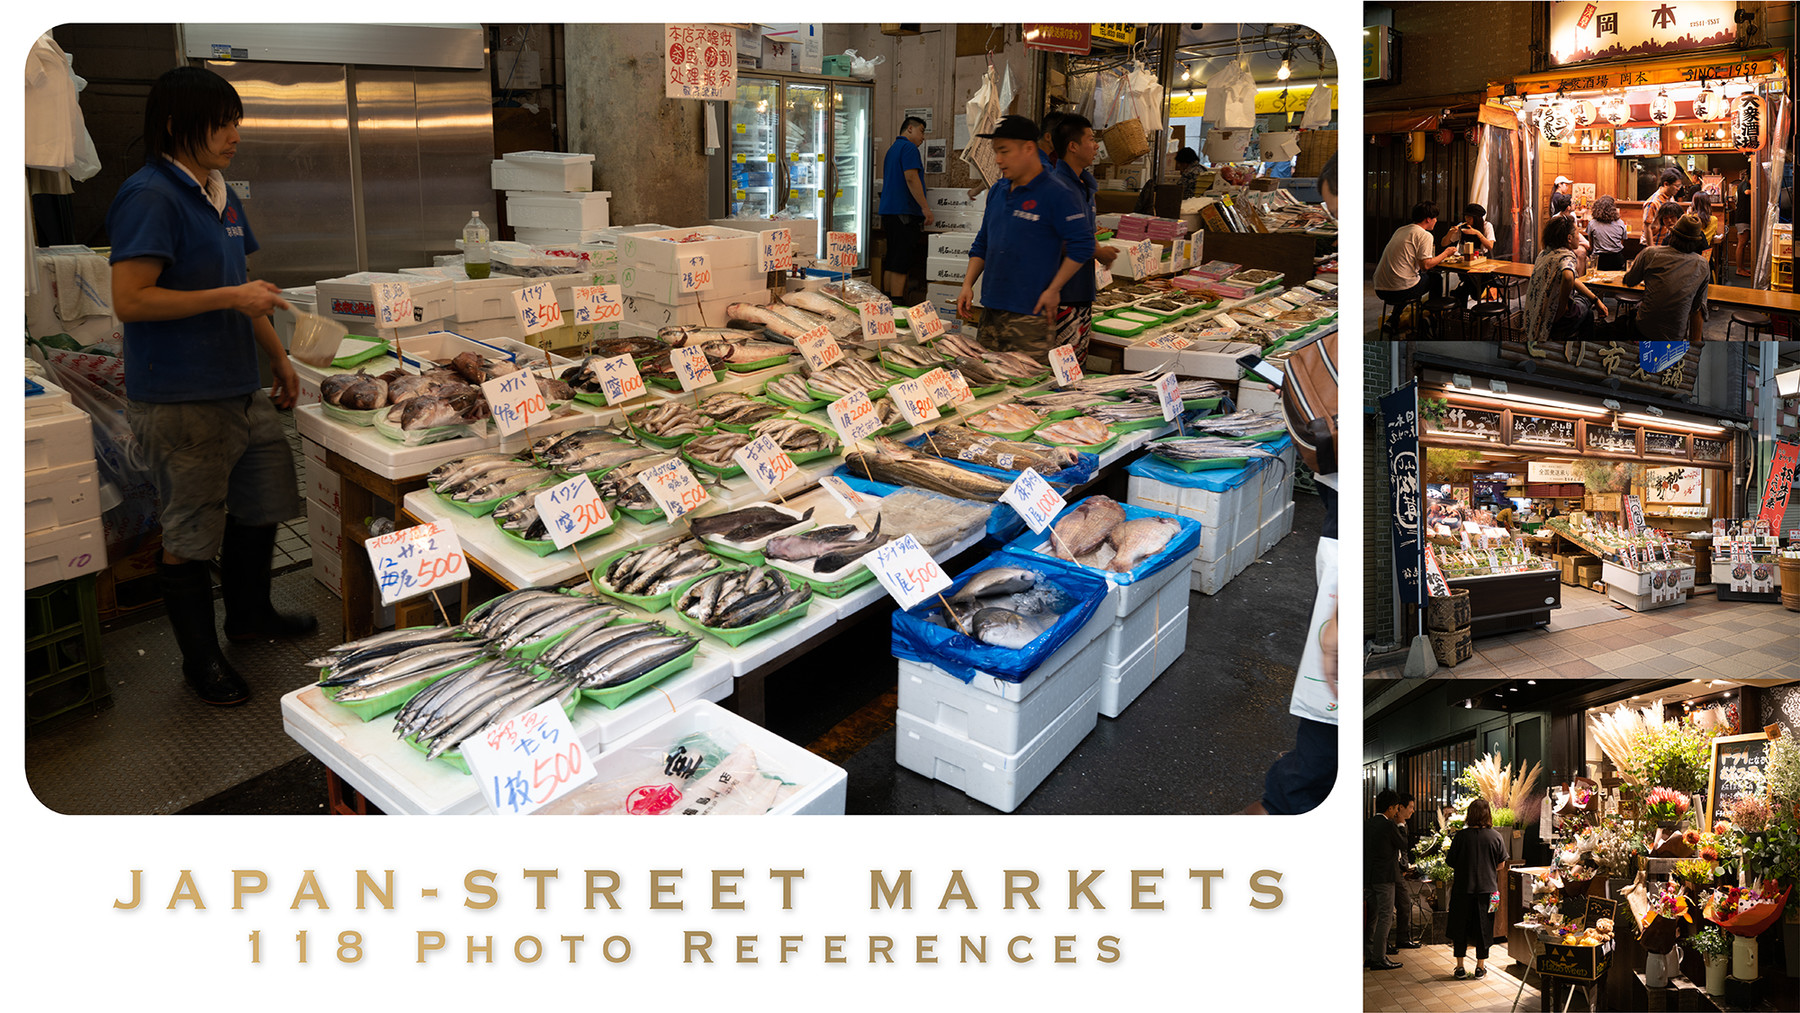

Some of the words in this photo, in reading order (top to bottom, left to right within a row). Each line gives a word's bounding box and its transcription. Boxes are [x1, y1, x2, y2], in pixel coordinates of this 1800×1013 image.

[1596, 3, 1677, 38] 岡本
[1620, 71, 1648, 85] 岡本
[1728, 62, 1758, 76] 1959
[1741, 95, 1760, 150] 大衆酒場
[694, 270, 711, 289] 500
[393, 298, 412, 322] 500
[538, 302, 560, 328] 500
[592, 303, 621, 321] 500
[604, 358, 627, 372] キス
[500, 371, 527, 393] サバ
[620, 375, 643, 397] 1000
[515, 394, 546, 427] 700
[850, 401, 872, 421] 2000
[916, 397, 934, 418] 800
[768, 452, 792, 481] 500
[551, 479, 586, 504] イワシ
[681, 485, 706, 511] 500
[1036, 489, 1060, 517] 1000
[573, 498, 606, 534] 300
[417, 552, 462, 587] 500
[905, 562, 937, 592] 500
[514, 722, 559, 756] たら
[533, 742, 581, 804] 500
